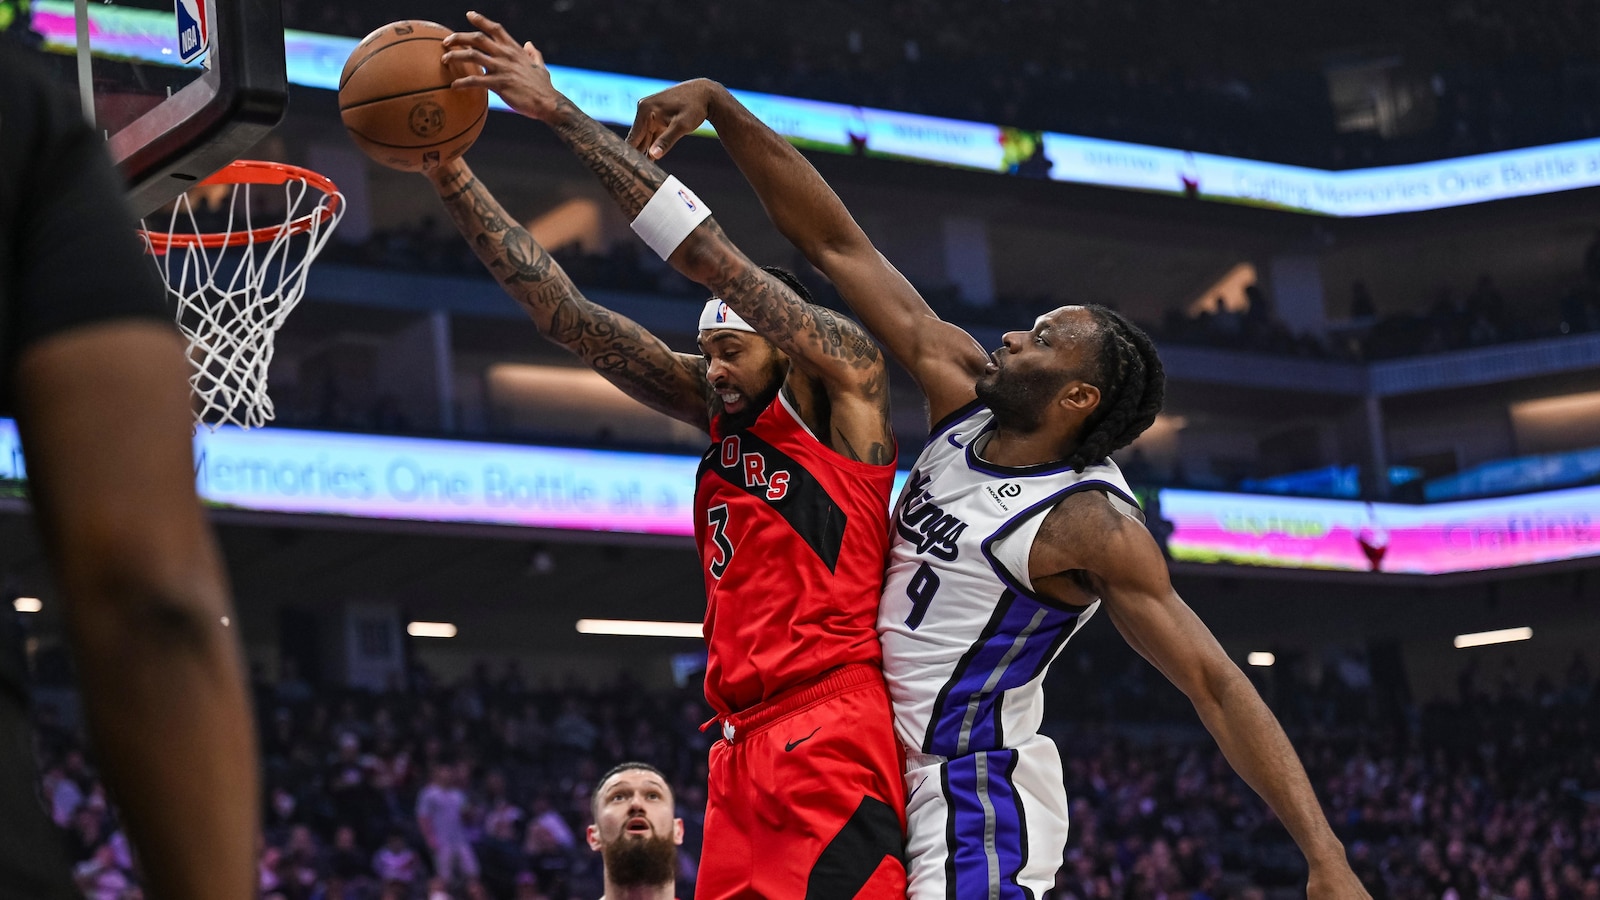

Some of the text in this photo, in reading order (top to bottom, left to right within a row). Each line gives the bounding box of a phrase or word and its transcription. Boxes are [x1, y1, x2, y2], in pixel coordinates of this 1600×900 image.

[181, 25, 198, 54] NBA
[1437, 168, 1495, 198] One
[1500, 153, 1577, 187] Bottle
[386, 456, 472, 506] One
[482, 463, 598, 512] Bottle
[607, 480, 647, 515] at
[653, 482, 678, 517] a
[896, 469, 969, 562] Kings
[707, 503, 735, 580] 3
[1441, 507, 1592, 556] Crafting
[904, 560, 941, 632] 9
